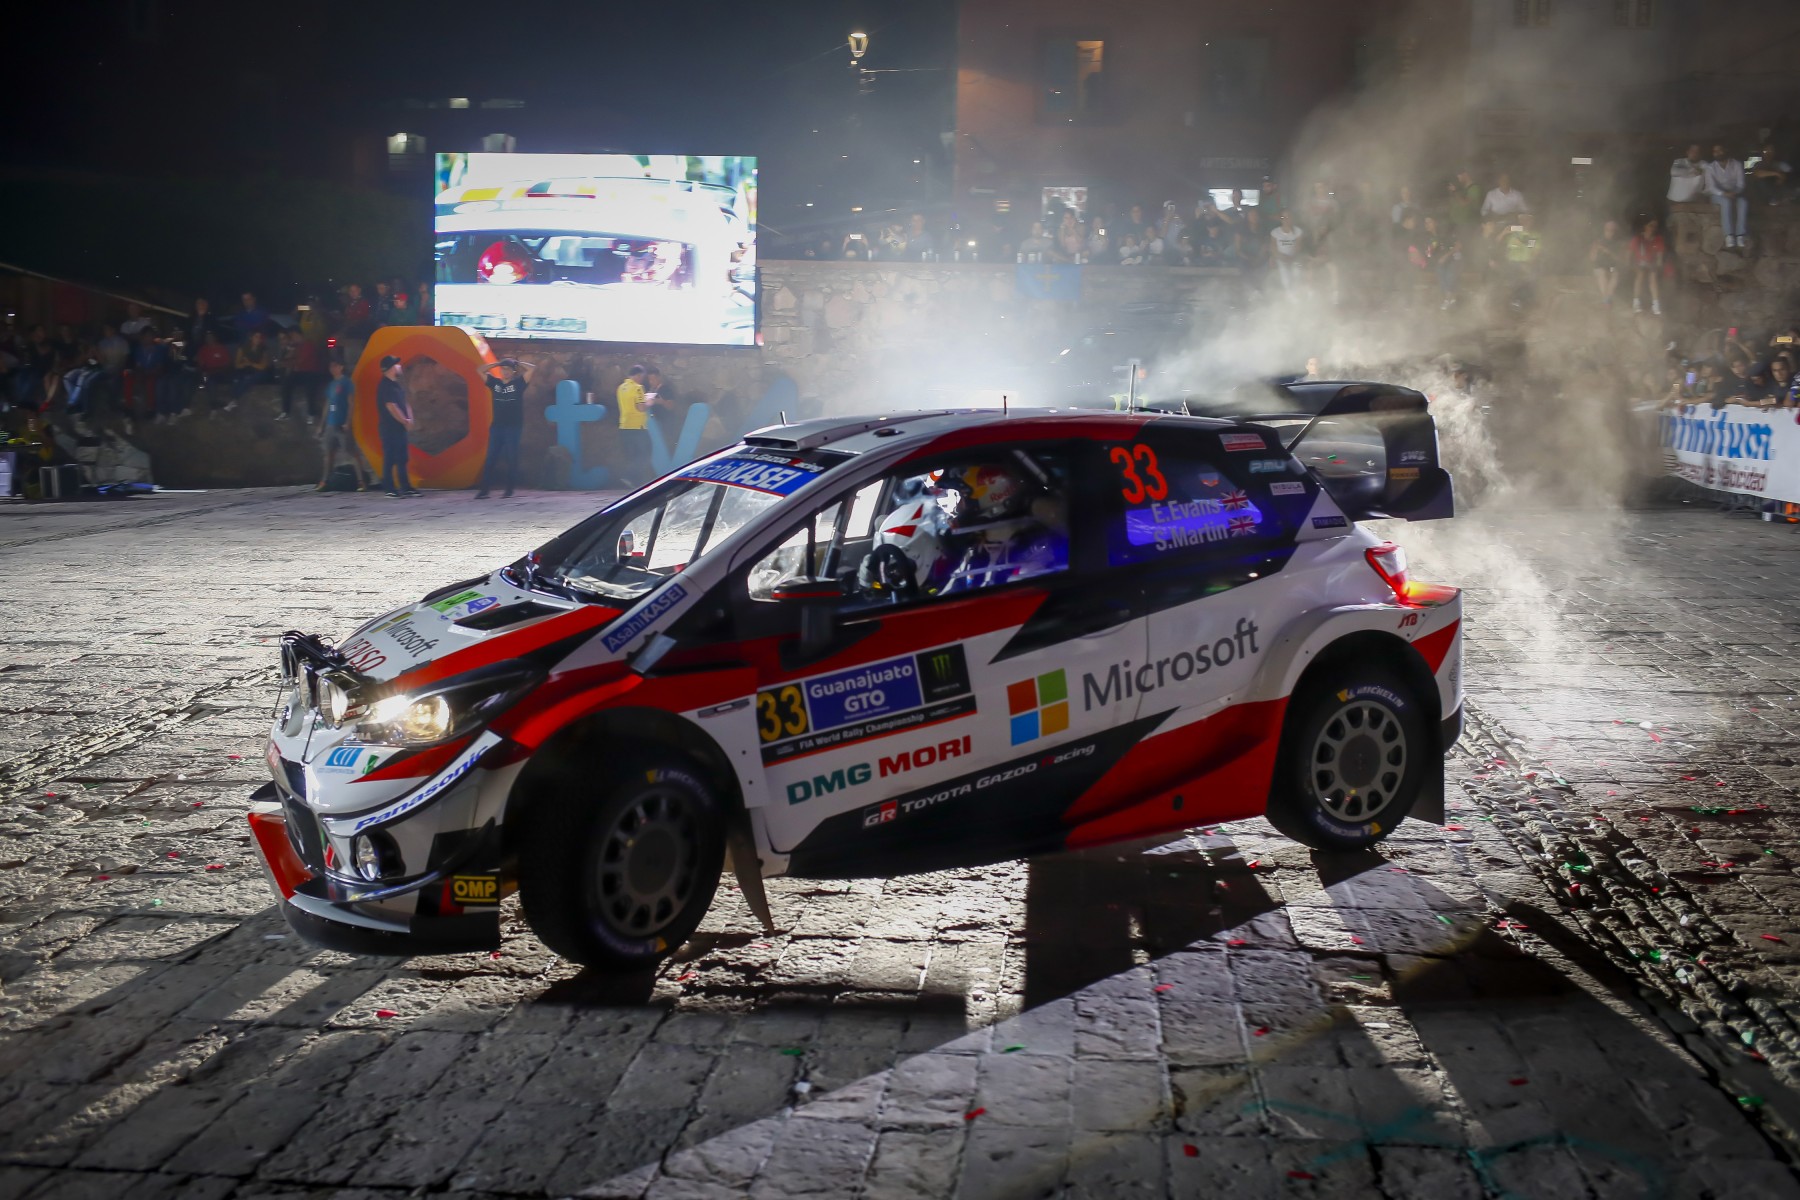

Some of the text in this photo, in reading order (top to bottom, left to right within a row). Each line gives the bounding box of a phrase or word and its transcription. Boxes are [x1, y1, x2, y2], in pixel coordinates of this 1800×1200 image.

[1110, 443, 1168, 504] 33
[1151, 498, 1222, 524] E.Evans
[1153, 521, 1229, 552] S.Martin
[607, 585, 684, 651] AsahiKASEI
[810, 664, 914, 698] Guanajuato
[1082, 617, 1260, 712] Microsoft
[756, 685, 809, 742] 33
[844, 689, 886, 713] GTO
[1357, 685, 1405, 708] MICHELIN
[799, 739, 815, 751] FIA
[815, 731, 841, 746] World
[842, 726, 864, 739] Rally
[865, 713, 926, 734] Championship
[354, 744, 490, 832] Panasonic
[786, 735, 972, 806] DMG MORI
[865, 743, 1097, 828] GR TOYOTA GAZOO Racing
[453, 880, 498, 899] OMP
